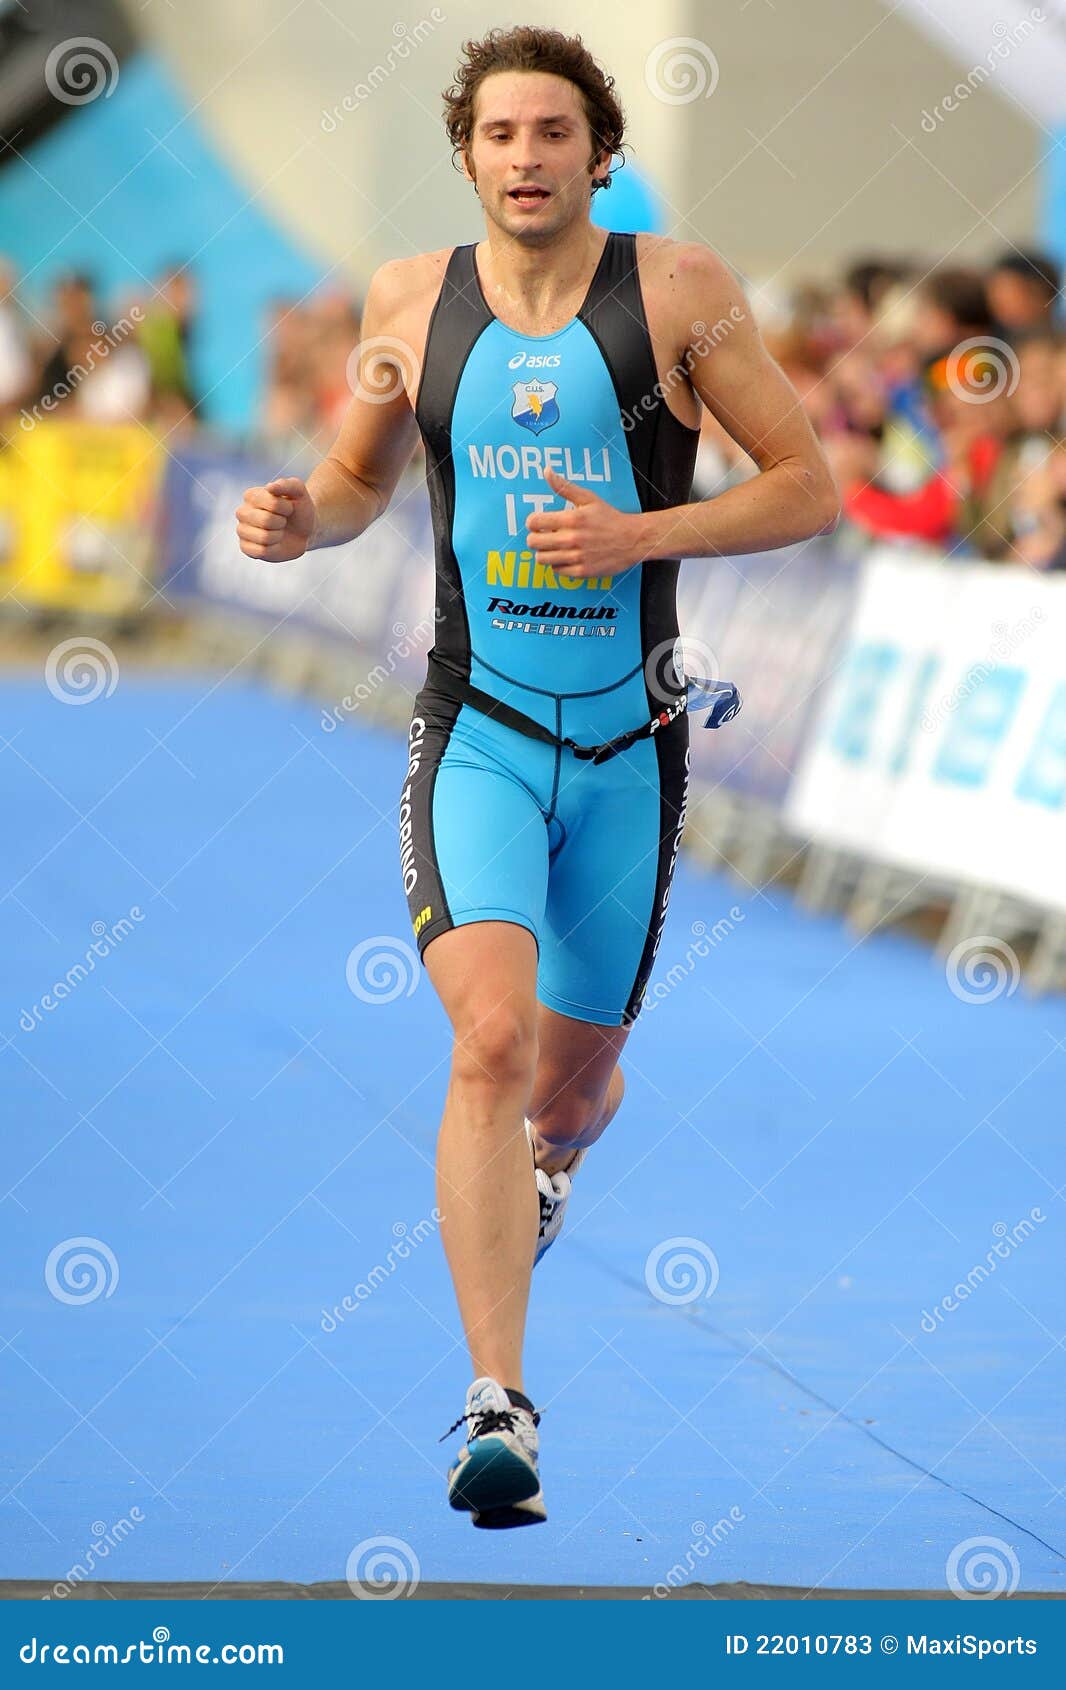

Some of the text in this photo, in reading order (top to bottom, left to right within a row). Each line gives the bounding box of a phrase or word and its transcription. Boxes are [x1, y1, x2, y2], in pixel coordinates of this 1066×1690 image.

[525, 354, 561, 368] asics
[468, 444, 612, 482] MORELLI
[505, 493, 577, 536] IT
[486, 597, 619, 620] Rodman
[491, 619, 616, 638] SPEEDIUM
[400, 784, 418, 896] TORINO
